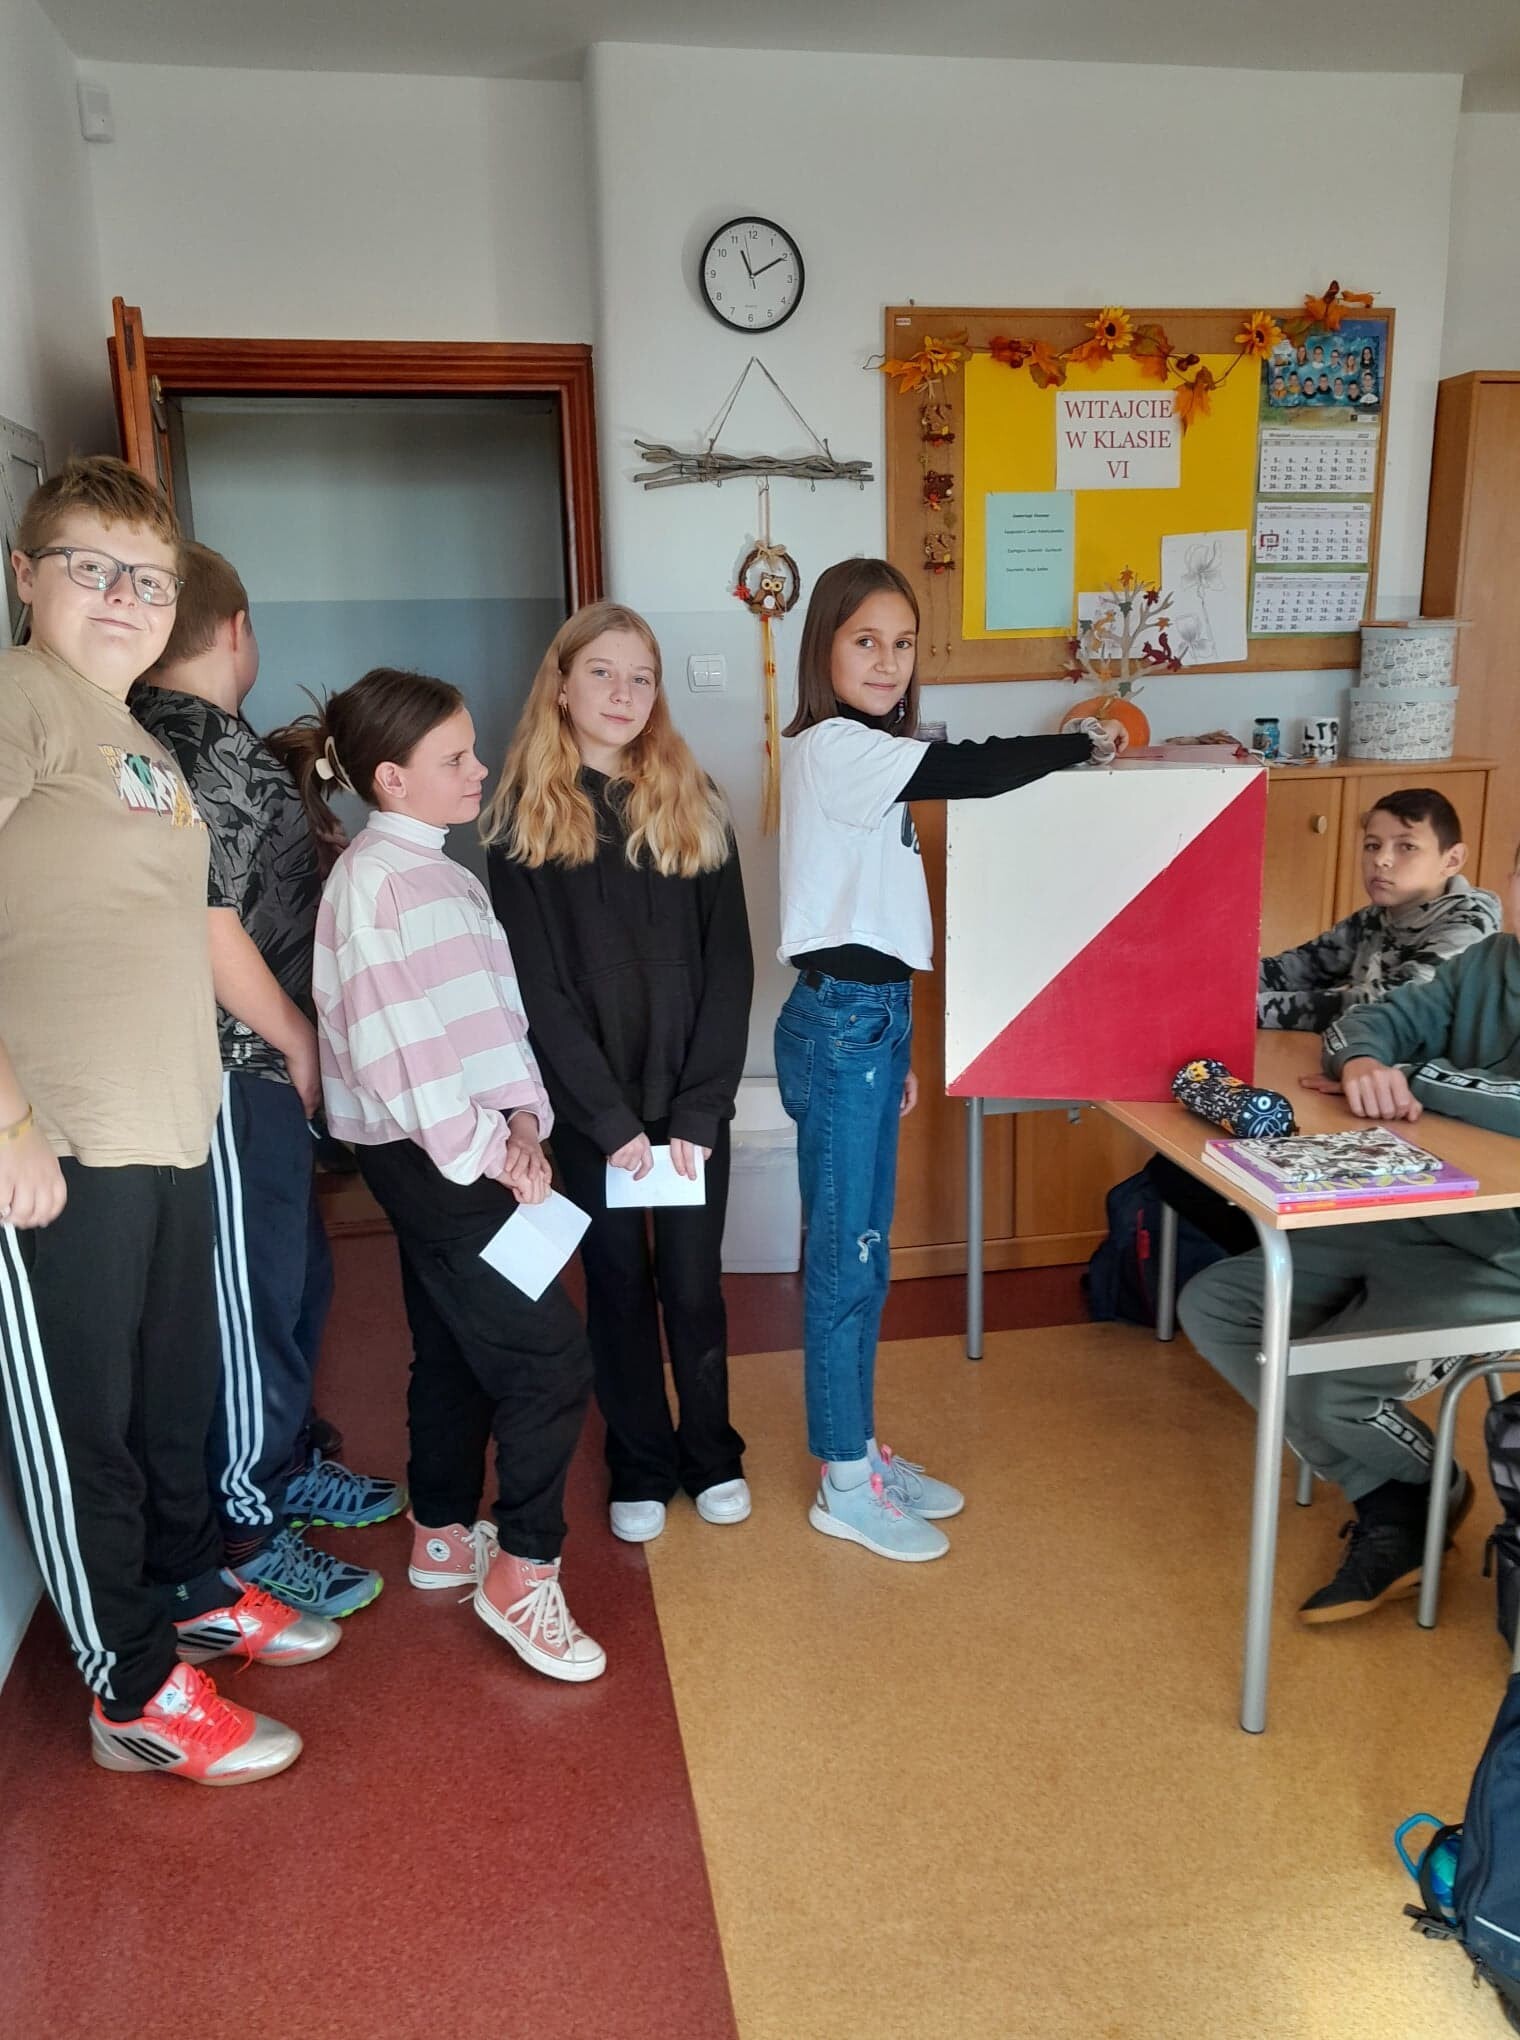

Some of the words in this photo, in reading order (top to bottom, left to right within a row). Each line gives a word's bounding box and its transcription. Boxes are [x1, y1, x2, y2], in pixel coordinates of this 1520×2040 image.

[749, 231, 759, 240] 12
[731, 236, 738, 244] 11
[770, 239, 773, 247] 1
[718, 249, 727, 257] 10
[782, 253, 788, 261] 2
[710, 270, 716, 278] 9
[787, 275, 793, 283] 3
[716, 292, 722, 300] 8
[781, 296, 786, 304] 4
[729, 307, 735, 315] 7
[767, 309, 773, 317] 5
[748, 314, 753, 322] 6
[1064, 400, 1172, 418] WITAJCIE
[1066, 431, 1087, 448] W
[1093, 431, 1171, 448] KLASIE
[1106, 461, 1130, 479] VI
